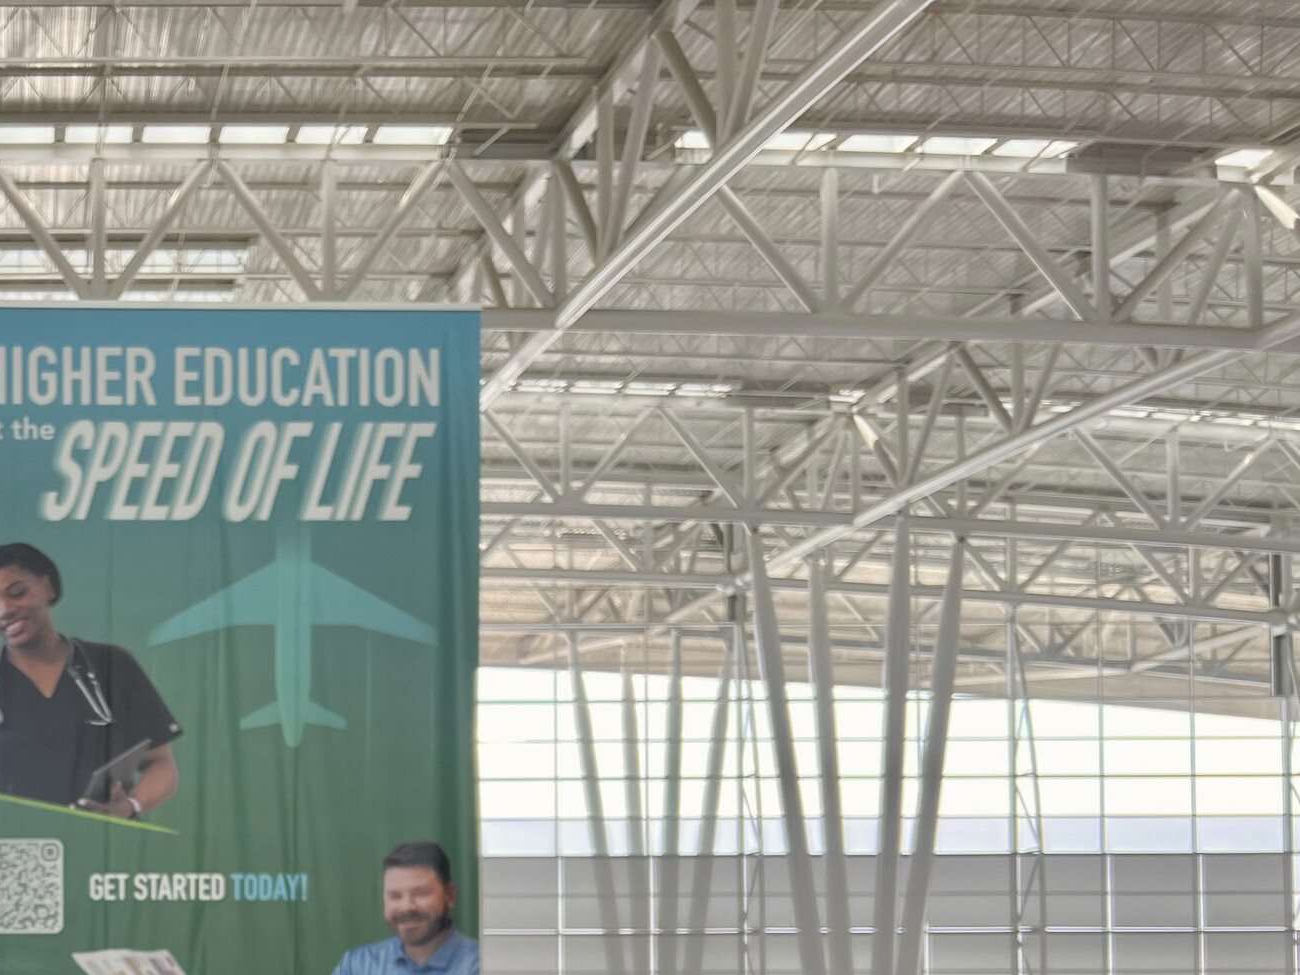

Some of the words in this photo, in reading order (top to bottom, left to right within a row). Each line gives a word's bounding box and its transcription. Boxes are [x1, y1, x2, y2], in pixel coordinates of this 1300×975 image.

[174, 347, 440, 407] EDUCATION
[11, 417, 56, 441] the
[41, 420, 224, 521] SPEED
[224, 421, 313, 522] OF
[303, 421, 437, 522] LIFE
[89, 873, 129, 901] GET
[133, 873, 226, 901] STARTED
[230, 873, 309, 901] TODAY!
